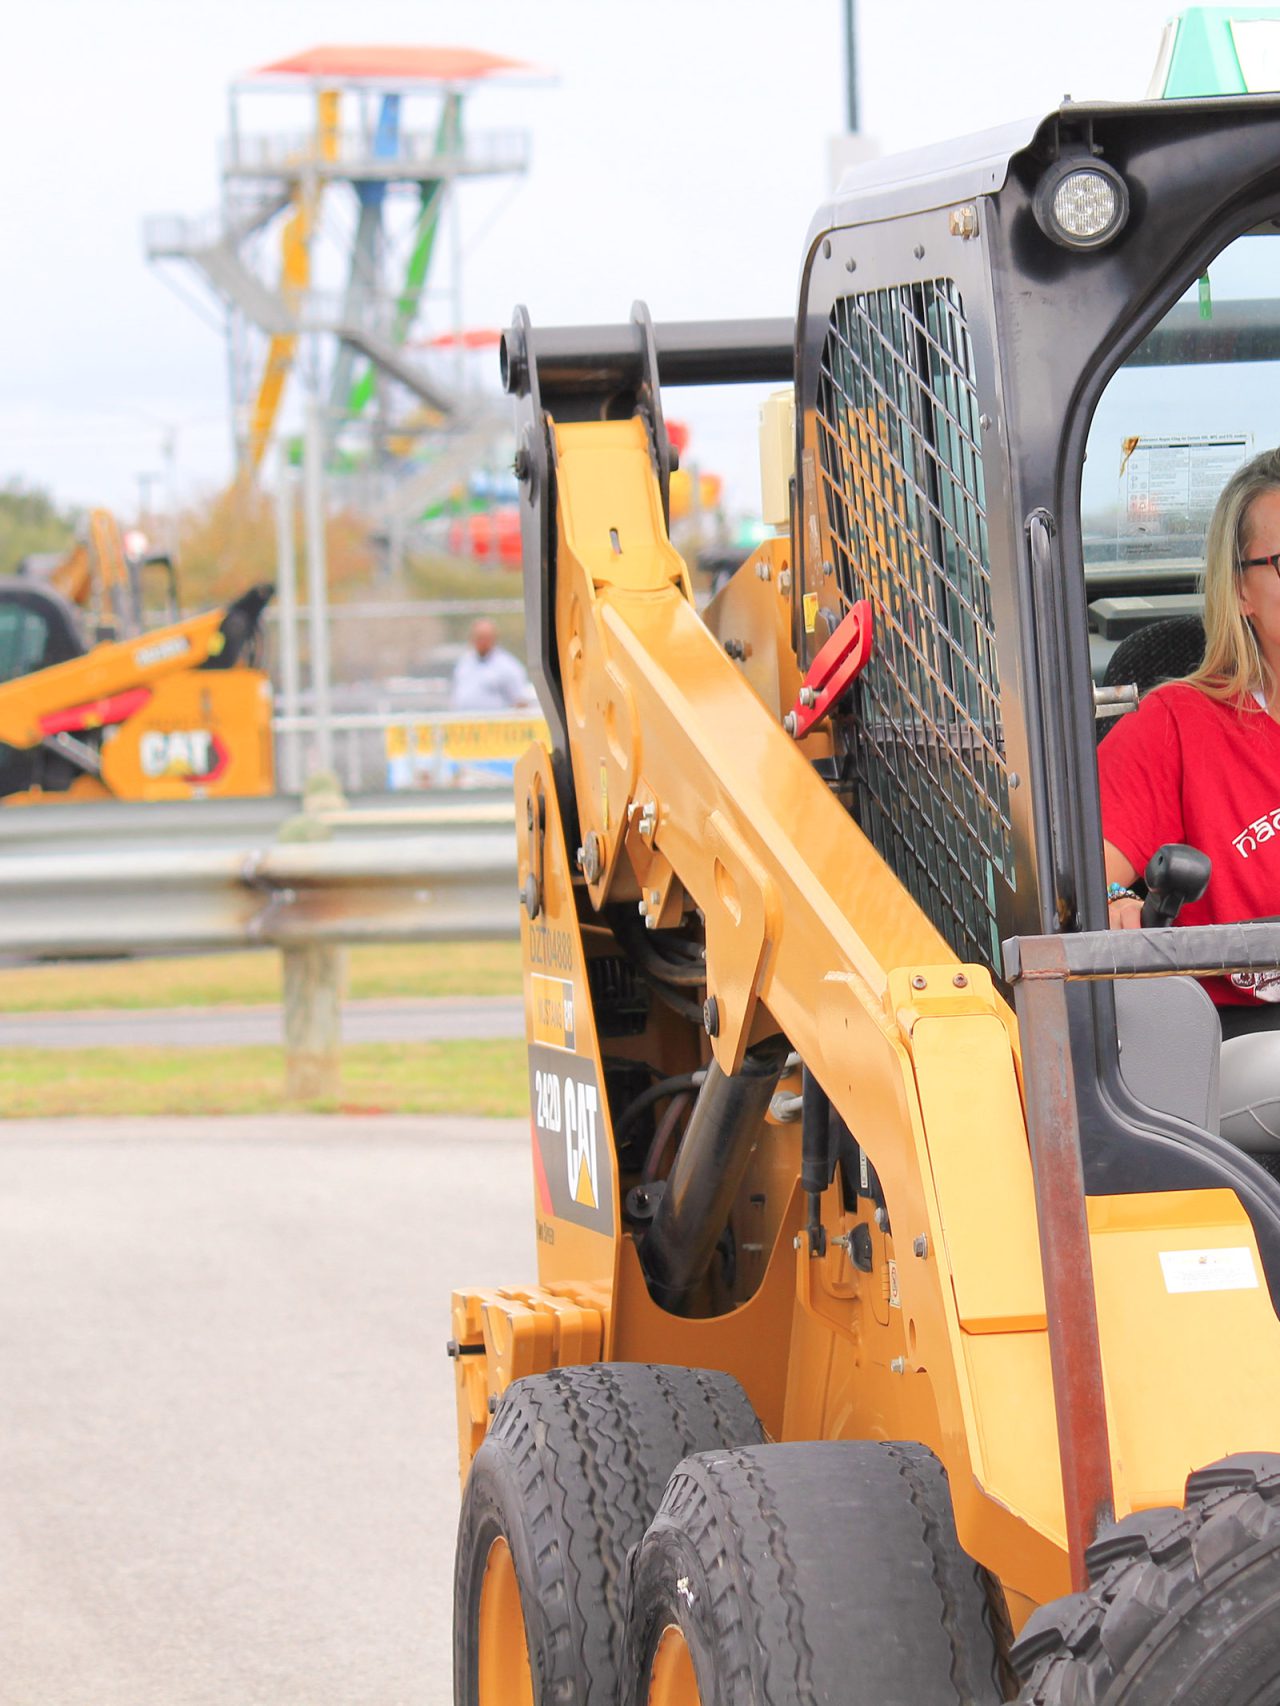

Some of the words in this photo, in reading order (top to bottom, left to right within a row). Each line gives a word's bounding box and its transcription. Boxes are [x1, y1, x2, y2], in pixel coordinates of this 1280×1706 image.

[140, 730, 213, 777] CAT
[535, 1070, 562, 1133] 242D
[564, 1077, 599, 1210] CAT
